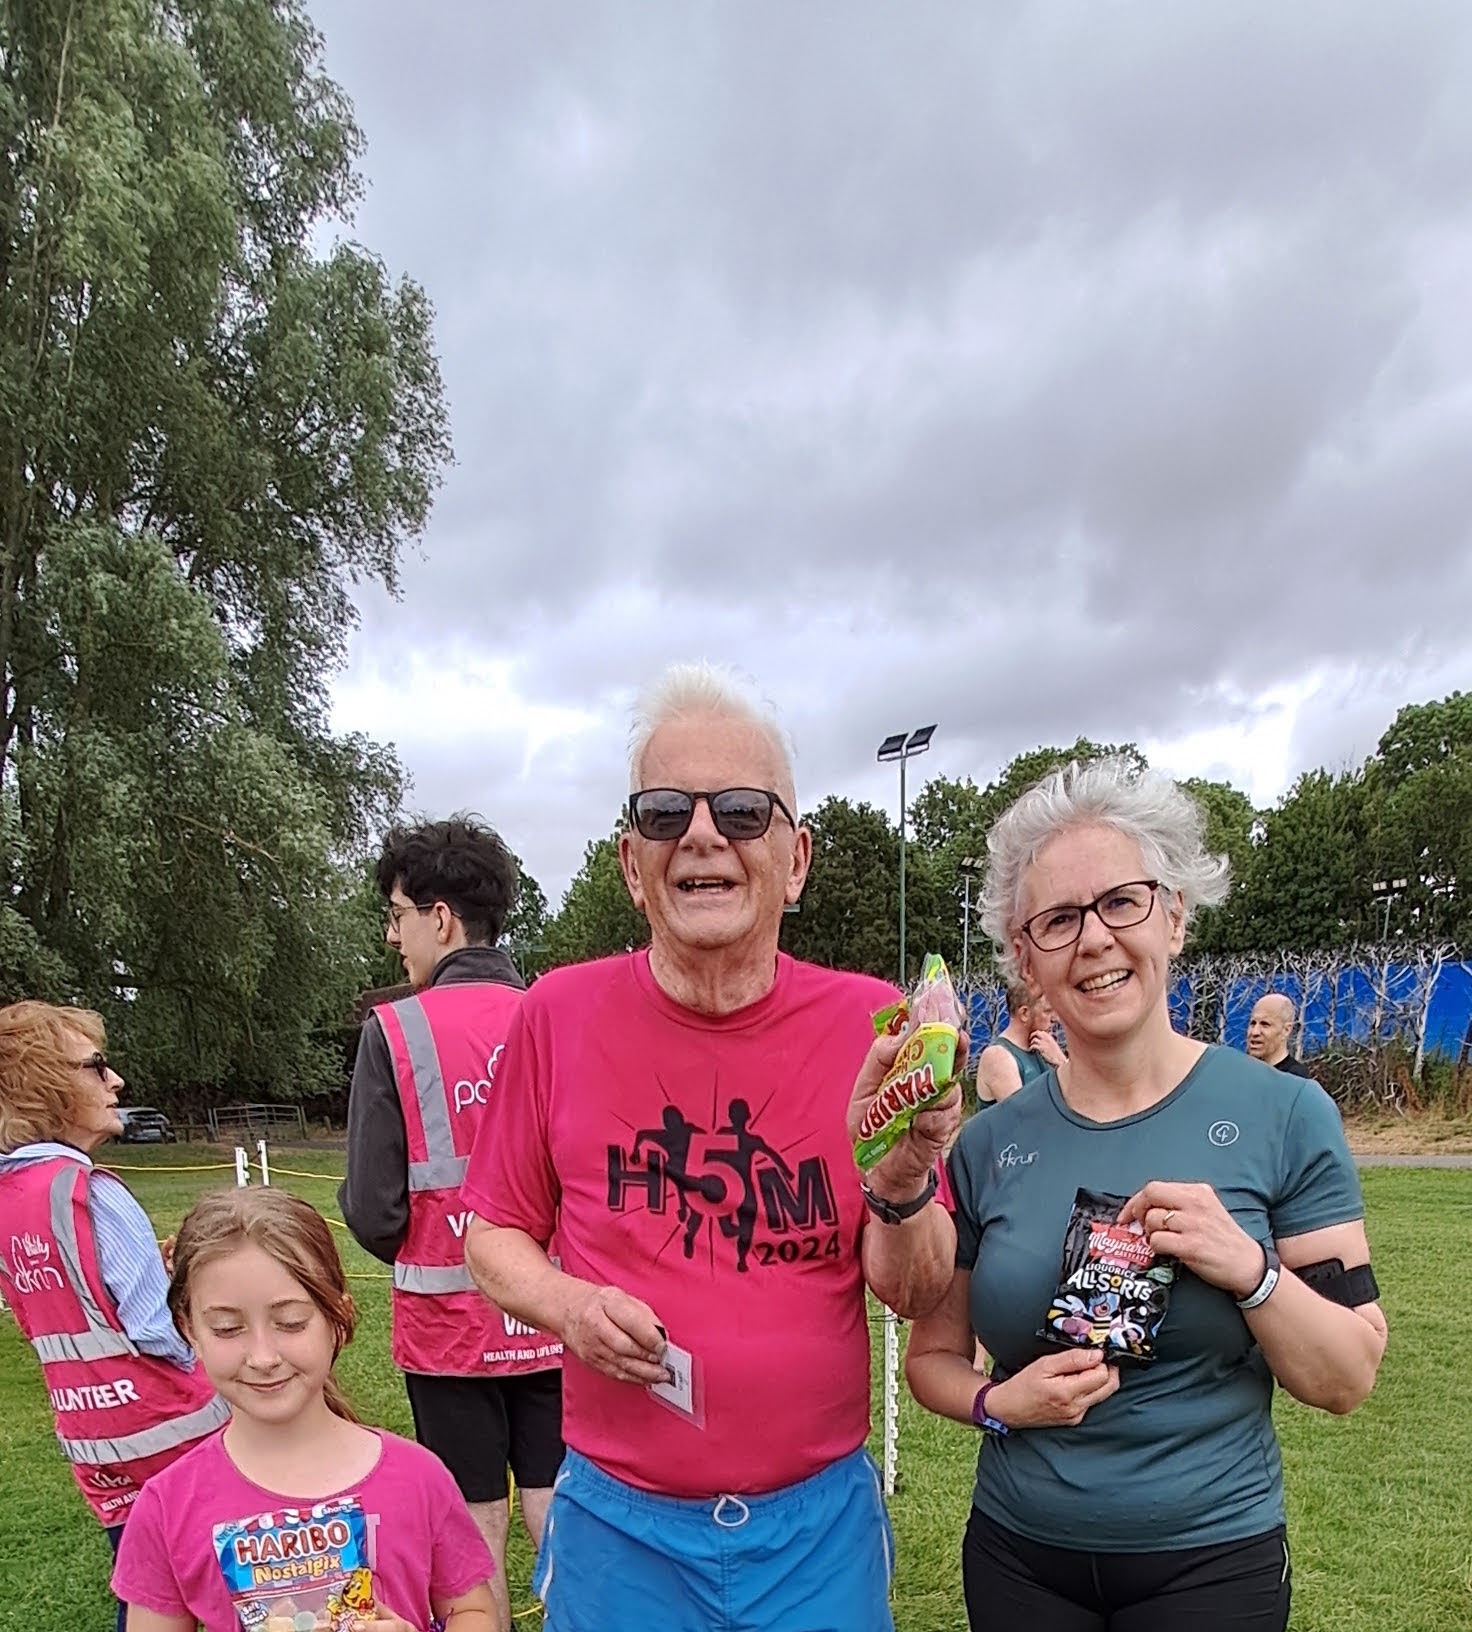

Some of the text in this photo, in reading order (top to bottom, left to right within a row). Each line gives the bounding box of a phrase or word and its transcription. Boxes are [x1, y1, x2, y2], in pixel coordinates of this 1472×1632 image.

[756, 1230, 841, 1266] 2024
[1088, 1231, 1155, 1258] Maynards
[1067, 1268, 1152, 1300] ALLSORTS
[1086, 1263, 1137, 1280] LIQUORICE
[483, 1350, 516, 1363] HEALTH
[517, 1348, 536, 1360] AND
[235, 1520, 350, 1565] HARIBO
[254, 1554, 342, 1585] Nostalgix
